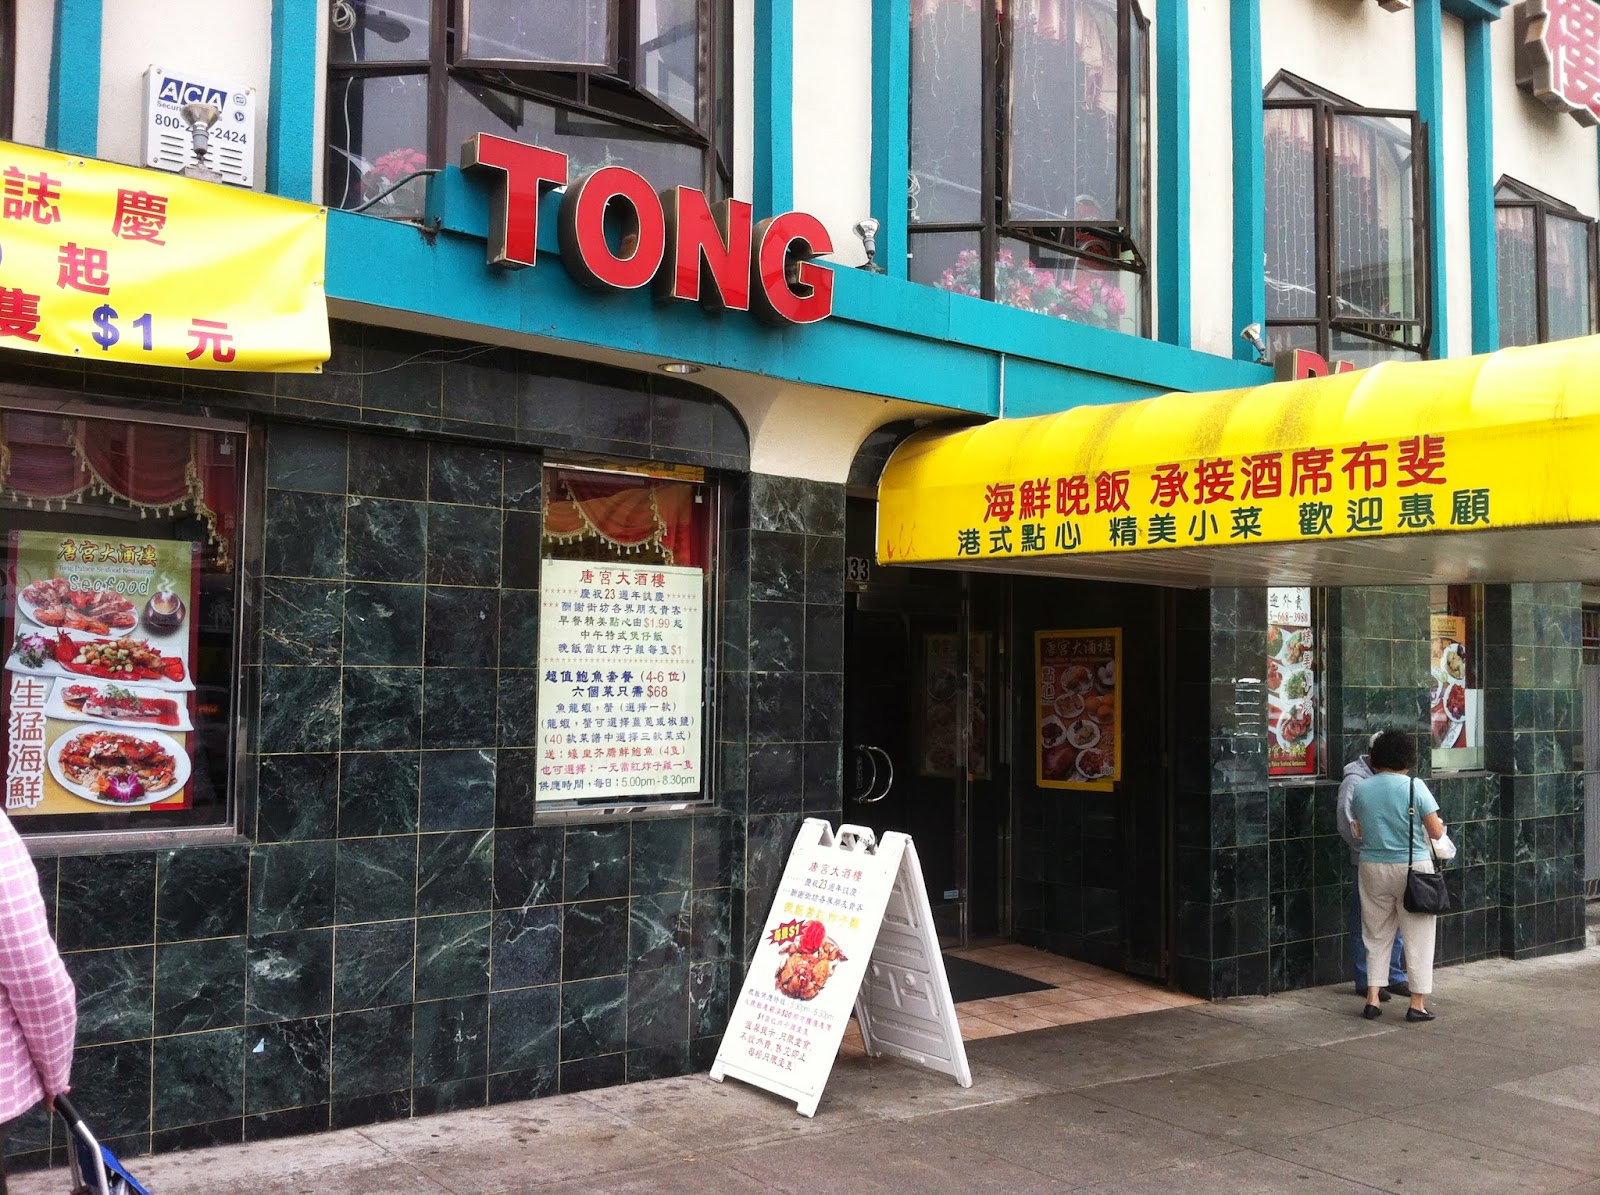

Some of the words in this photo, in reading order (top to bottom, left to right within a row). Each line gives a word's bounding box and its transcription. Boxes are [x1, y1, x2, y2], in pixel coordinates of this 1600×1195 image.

[157, 101, 182, 112] Securi
[159, 77, 227, 114] ACA
[155, 114, 247, 144] 800--2424
[476, 131, 835, 324] TONG
[57, 242, 111, 296] 起
[984, 470, 1131, 523] 海鮮晚飯
[957, 521, 1082, 556] 港式點心
[1109, 506, 1262, 547] 精美小菜
[1298, 488, 1490, 535] 歡迎惠顧
[57, 538, 158, 567] 唐宮大酒樓
[845, 558, 868, 580] 33
[69, 574, 150, 596] Seafood
[579, 569, 666, 588] 唐宮大酒樓
[8, 679, 46, 807] 生猛海鮮
